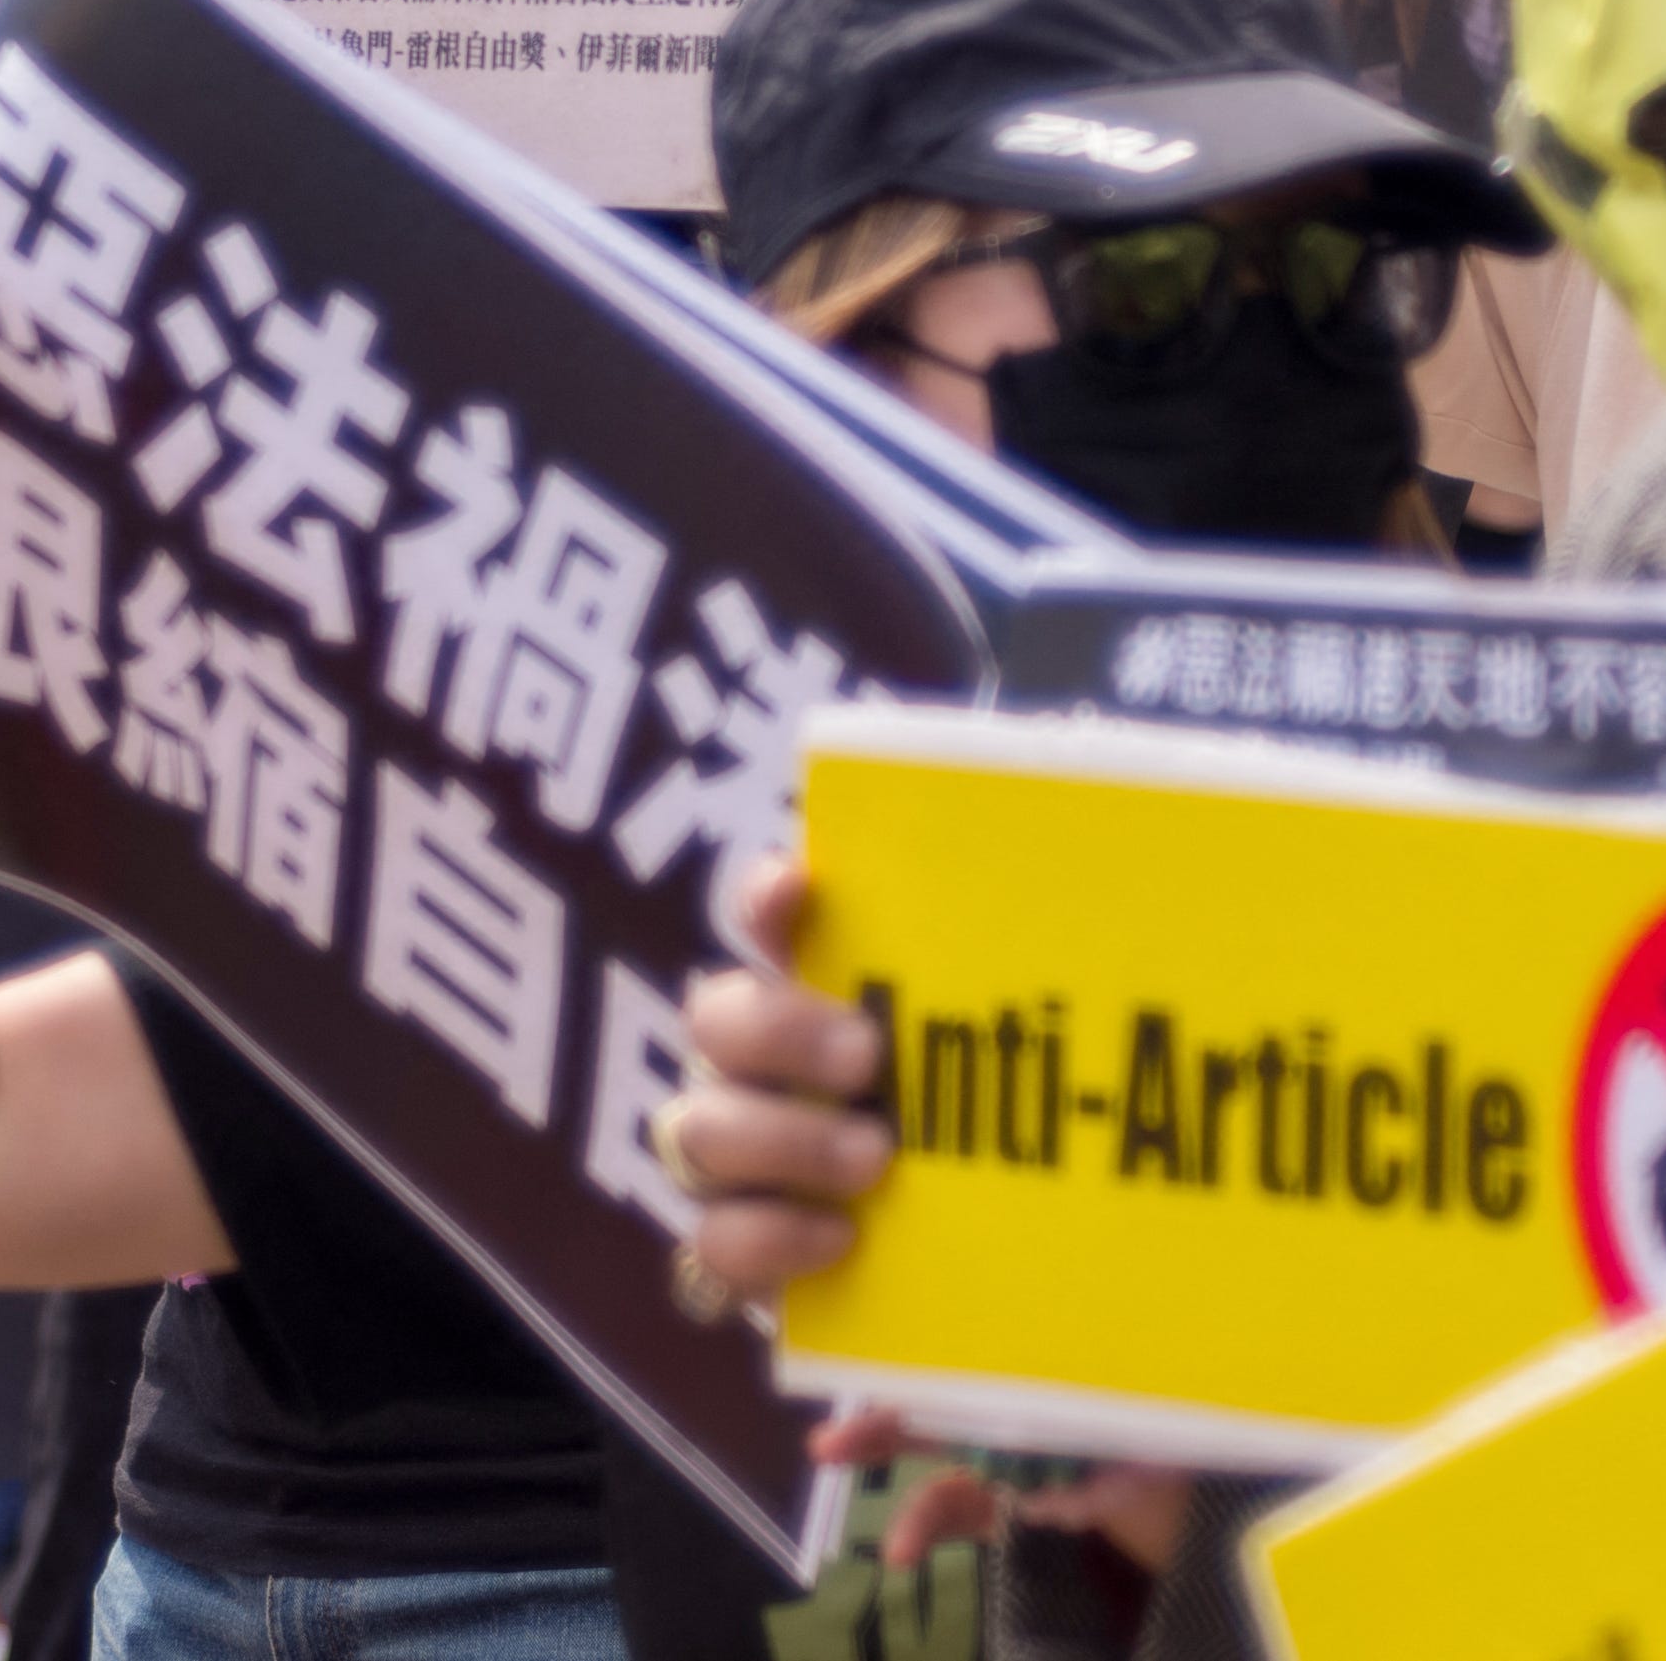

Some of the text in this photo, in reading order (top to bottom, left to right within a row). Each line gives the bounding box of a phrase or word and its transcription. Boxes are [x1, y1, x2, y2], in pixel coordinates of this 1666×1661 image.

[316, 27, 721, 75] 魯門-雷根自由獎、伊菲爾新聞
